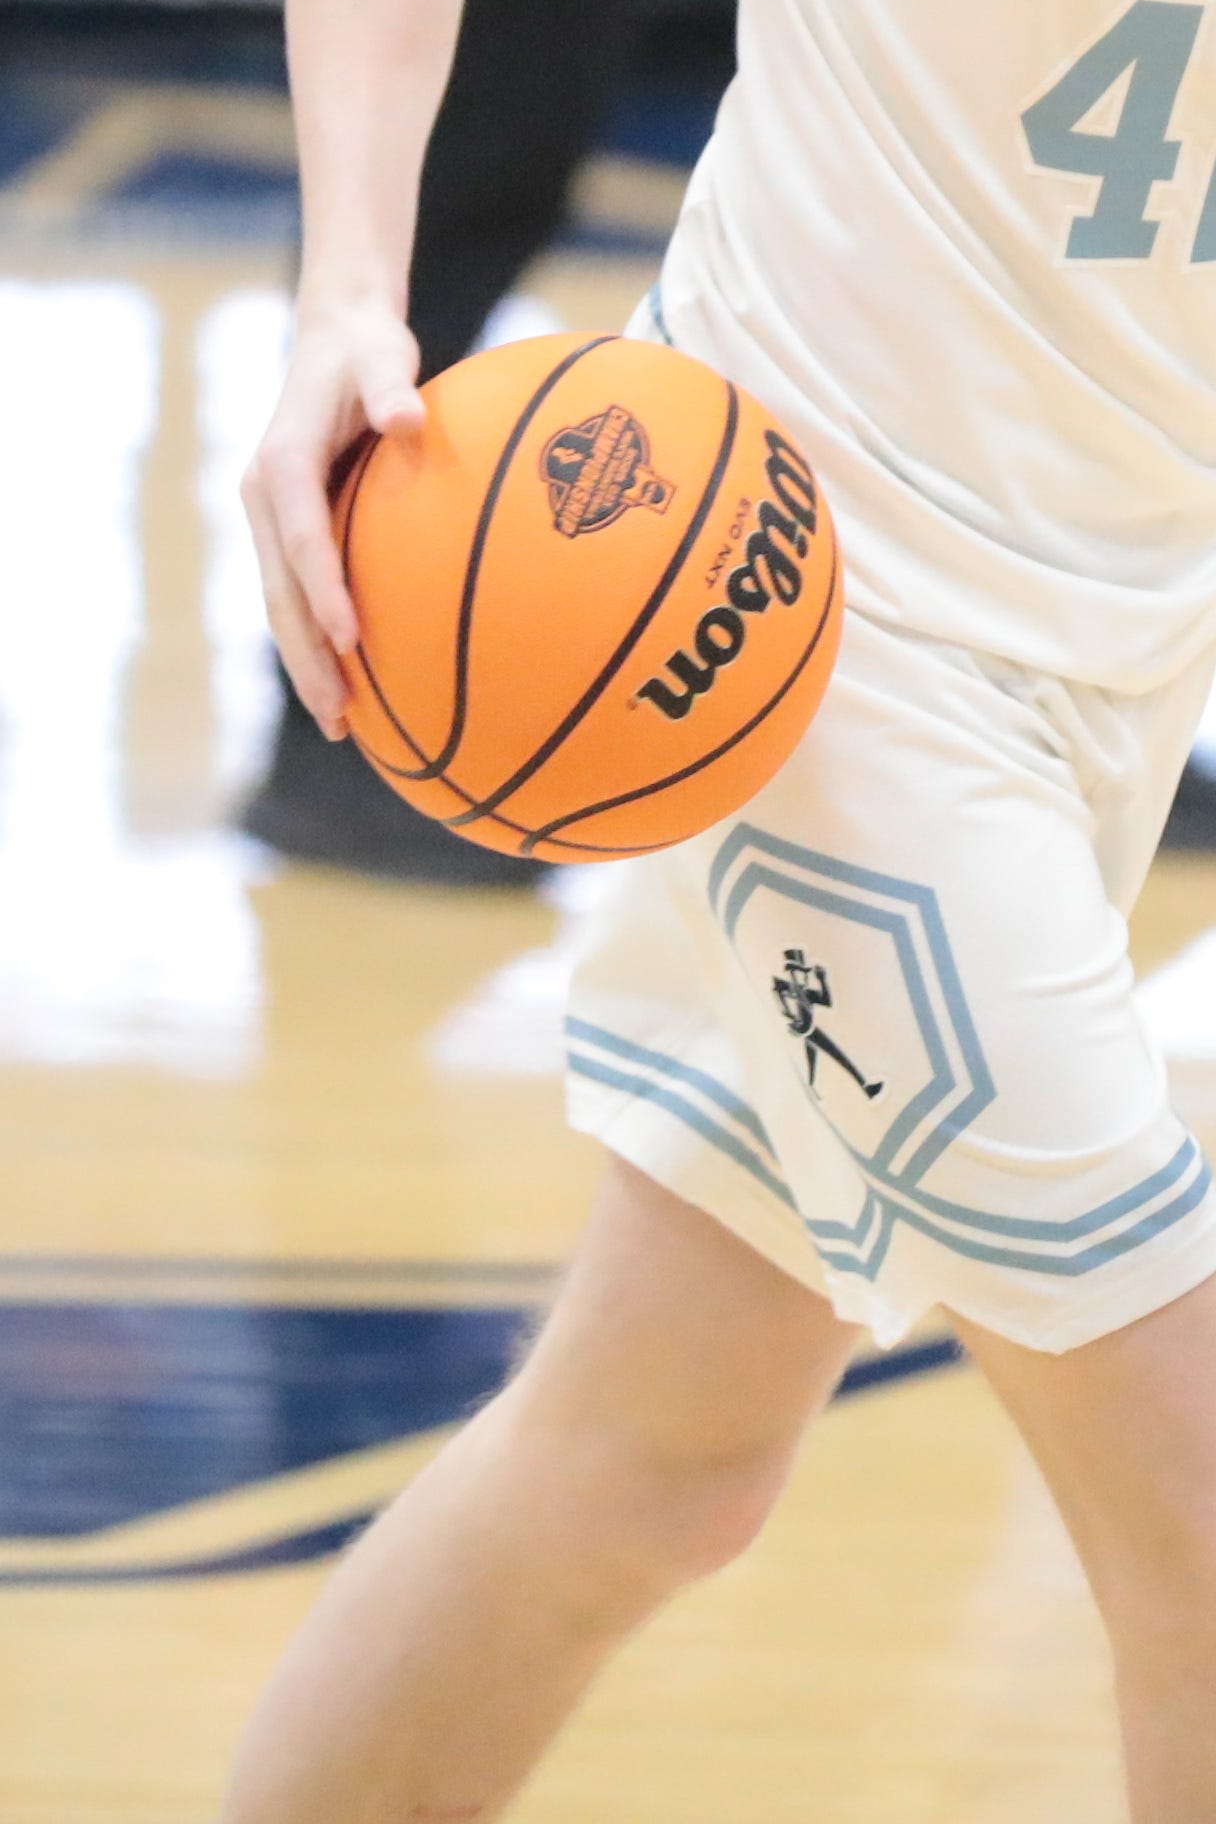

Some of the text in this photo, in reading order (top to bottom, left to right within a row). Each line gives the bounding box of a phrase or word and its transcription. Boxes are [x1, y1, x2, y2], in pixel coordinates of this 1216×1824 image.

[635, 428, 817, 720] Wilson
[705, 498, 751, 589] EVO NXT
